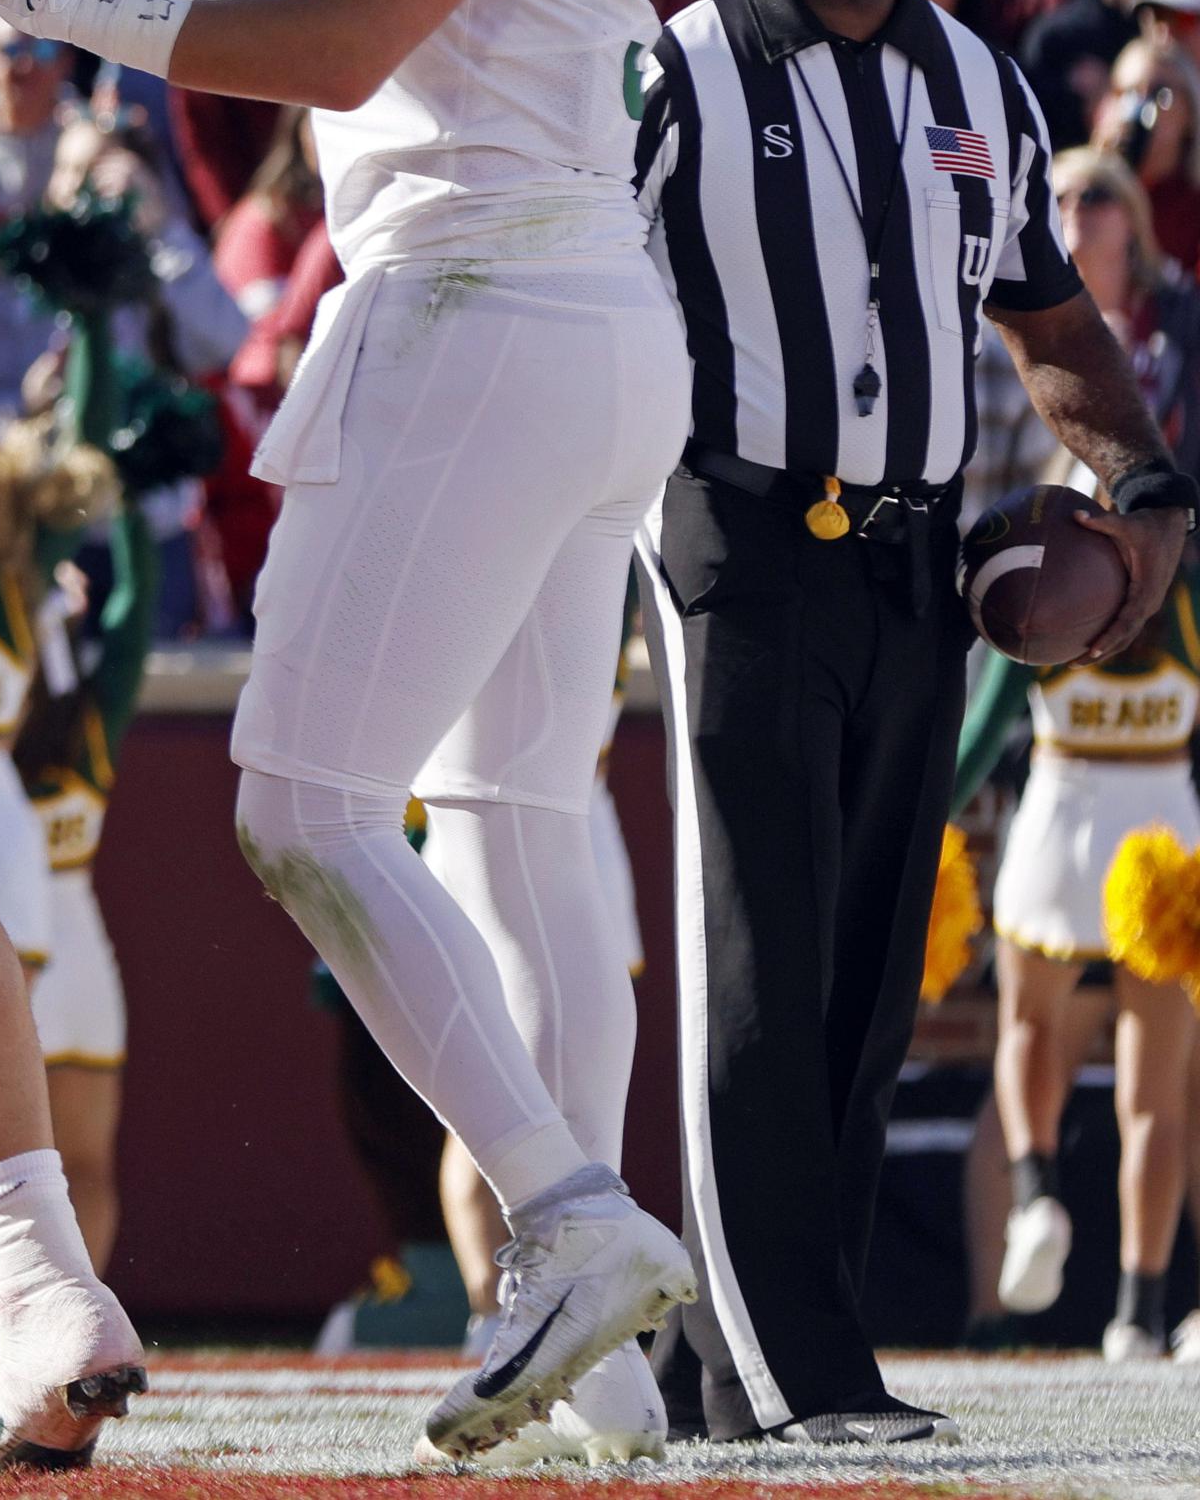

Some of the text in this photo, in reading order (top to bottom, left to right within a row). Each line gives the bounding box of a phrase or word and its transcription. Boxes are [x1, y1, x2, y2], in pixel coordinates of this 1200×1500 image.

[762, 123, 794, 159] S
[961, 234, 990, 286] U
[1070, 693, 1180, 728] BEARS
